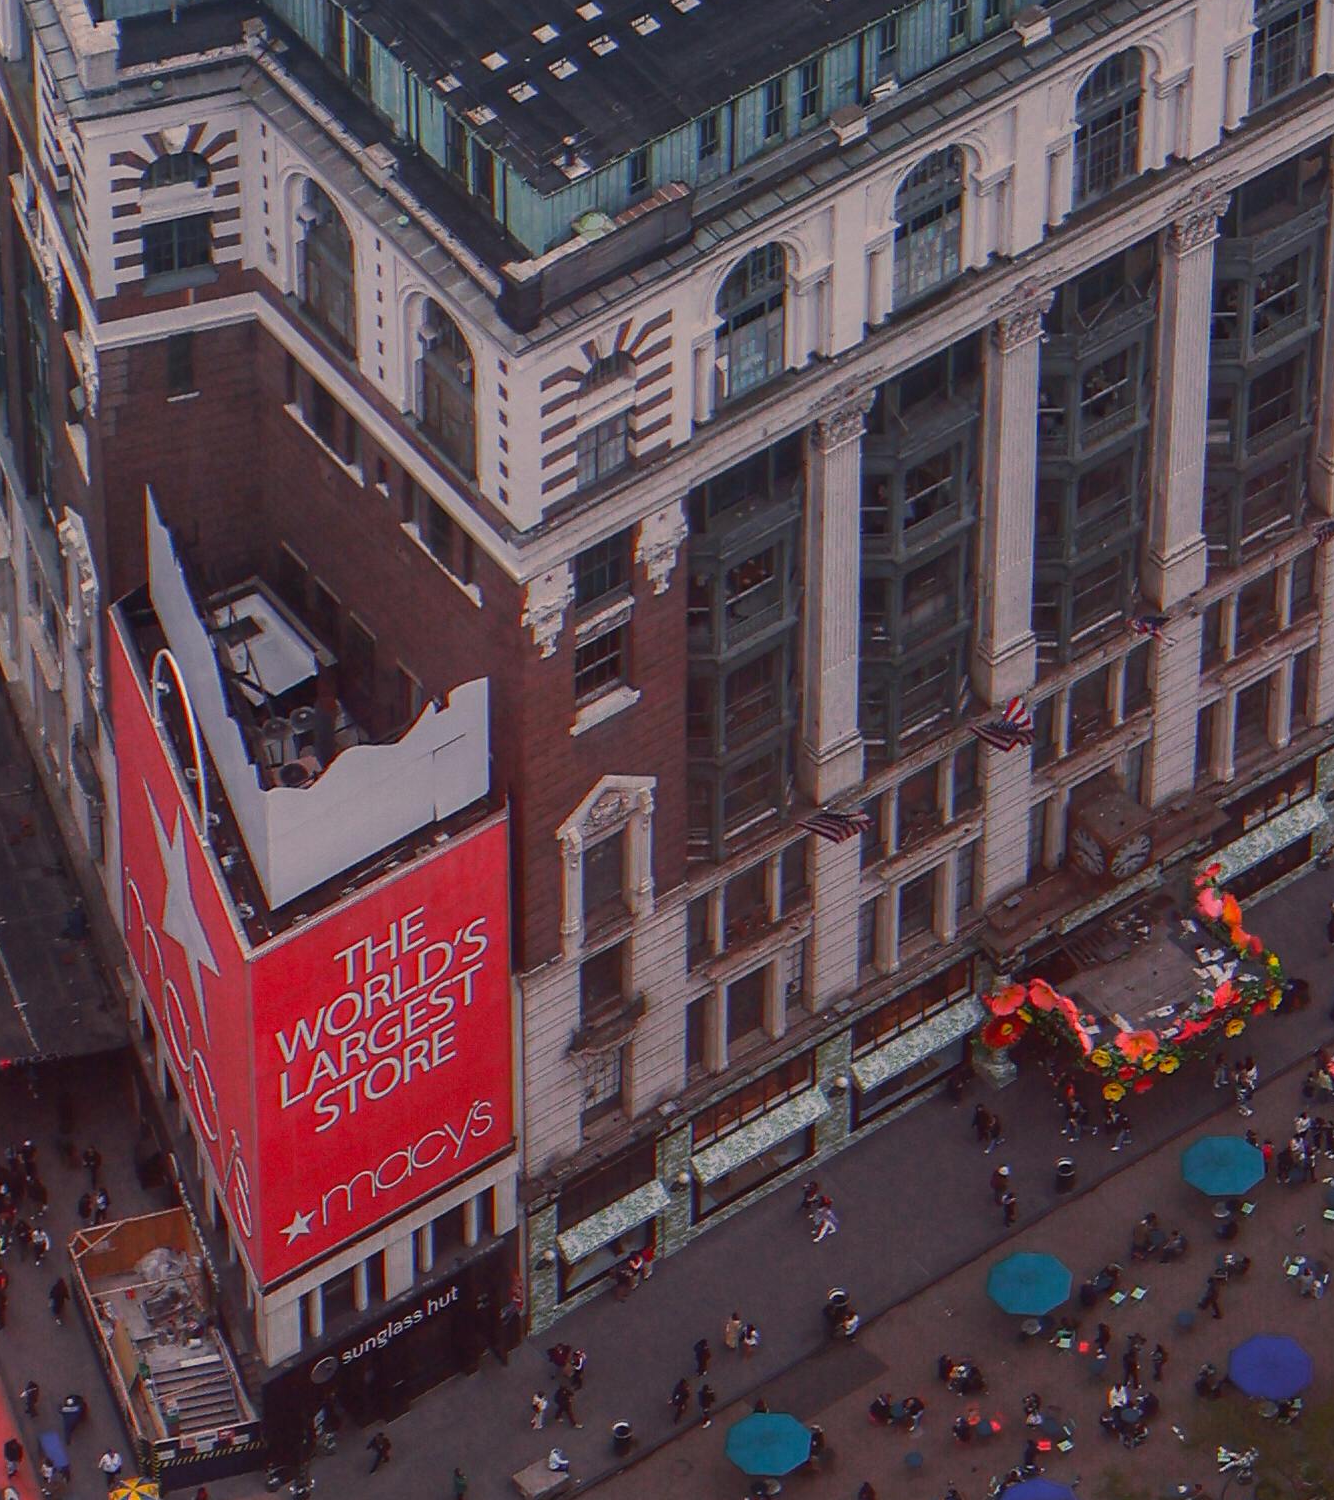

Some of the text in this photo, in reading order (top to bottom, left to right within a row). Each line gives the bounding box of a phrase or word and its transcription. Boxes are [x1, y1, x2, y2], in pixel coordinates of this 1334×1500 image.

[275, 917, 489, 1064] WORLD'S
[333, 906, 427, 985] THE
[280, 962, 484, 1109] LARGEST
[314, 1021, 457, 1133] STORE
[322, 1100, 494, 1226] macy's
[341, 1285, 460, 1365] sunglass hut
